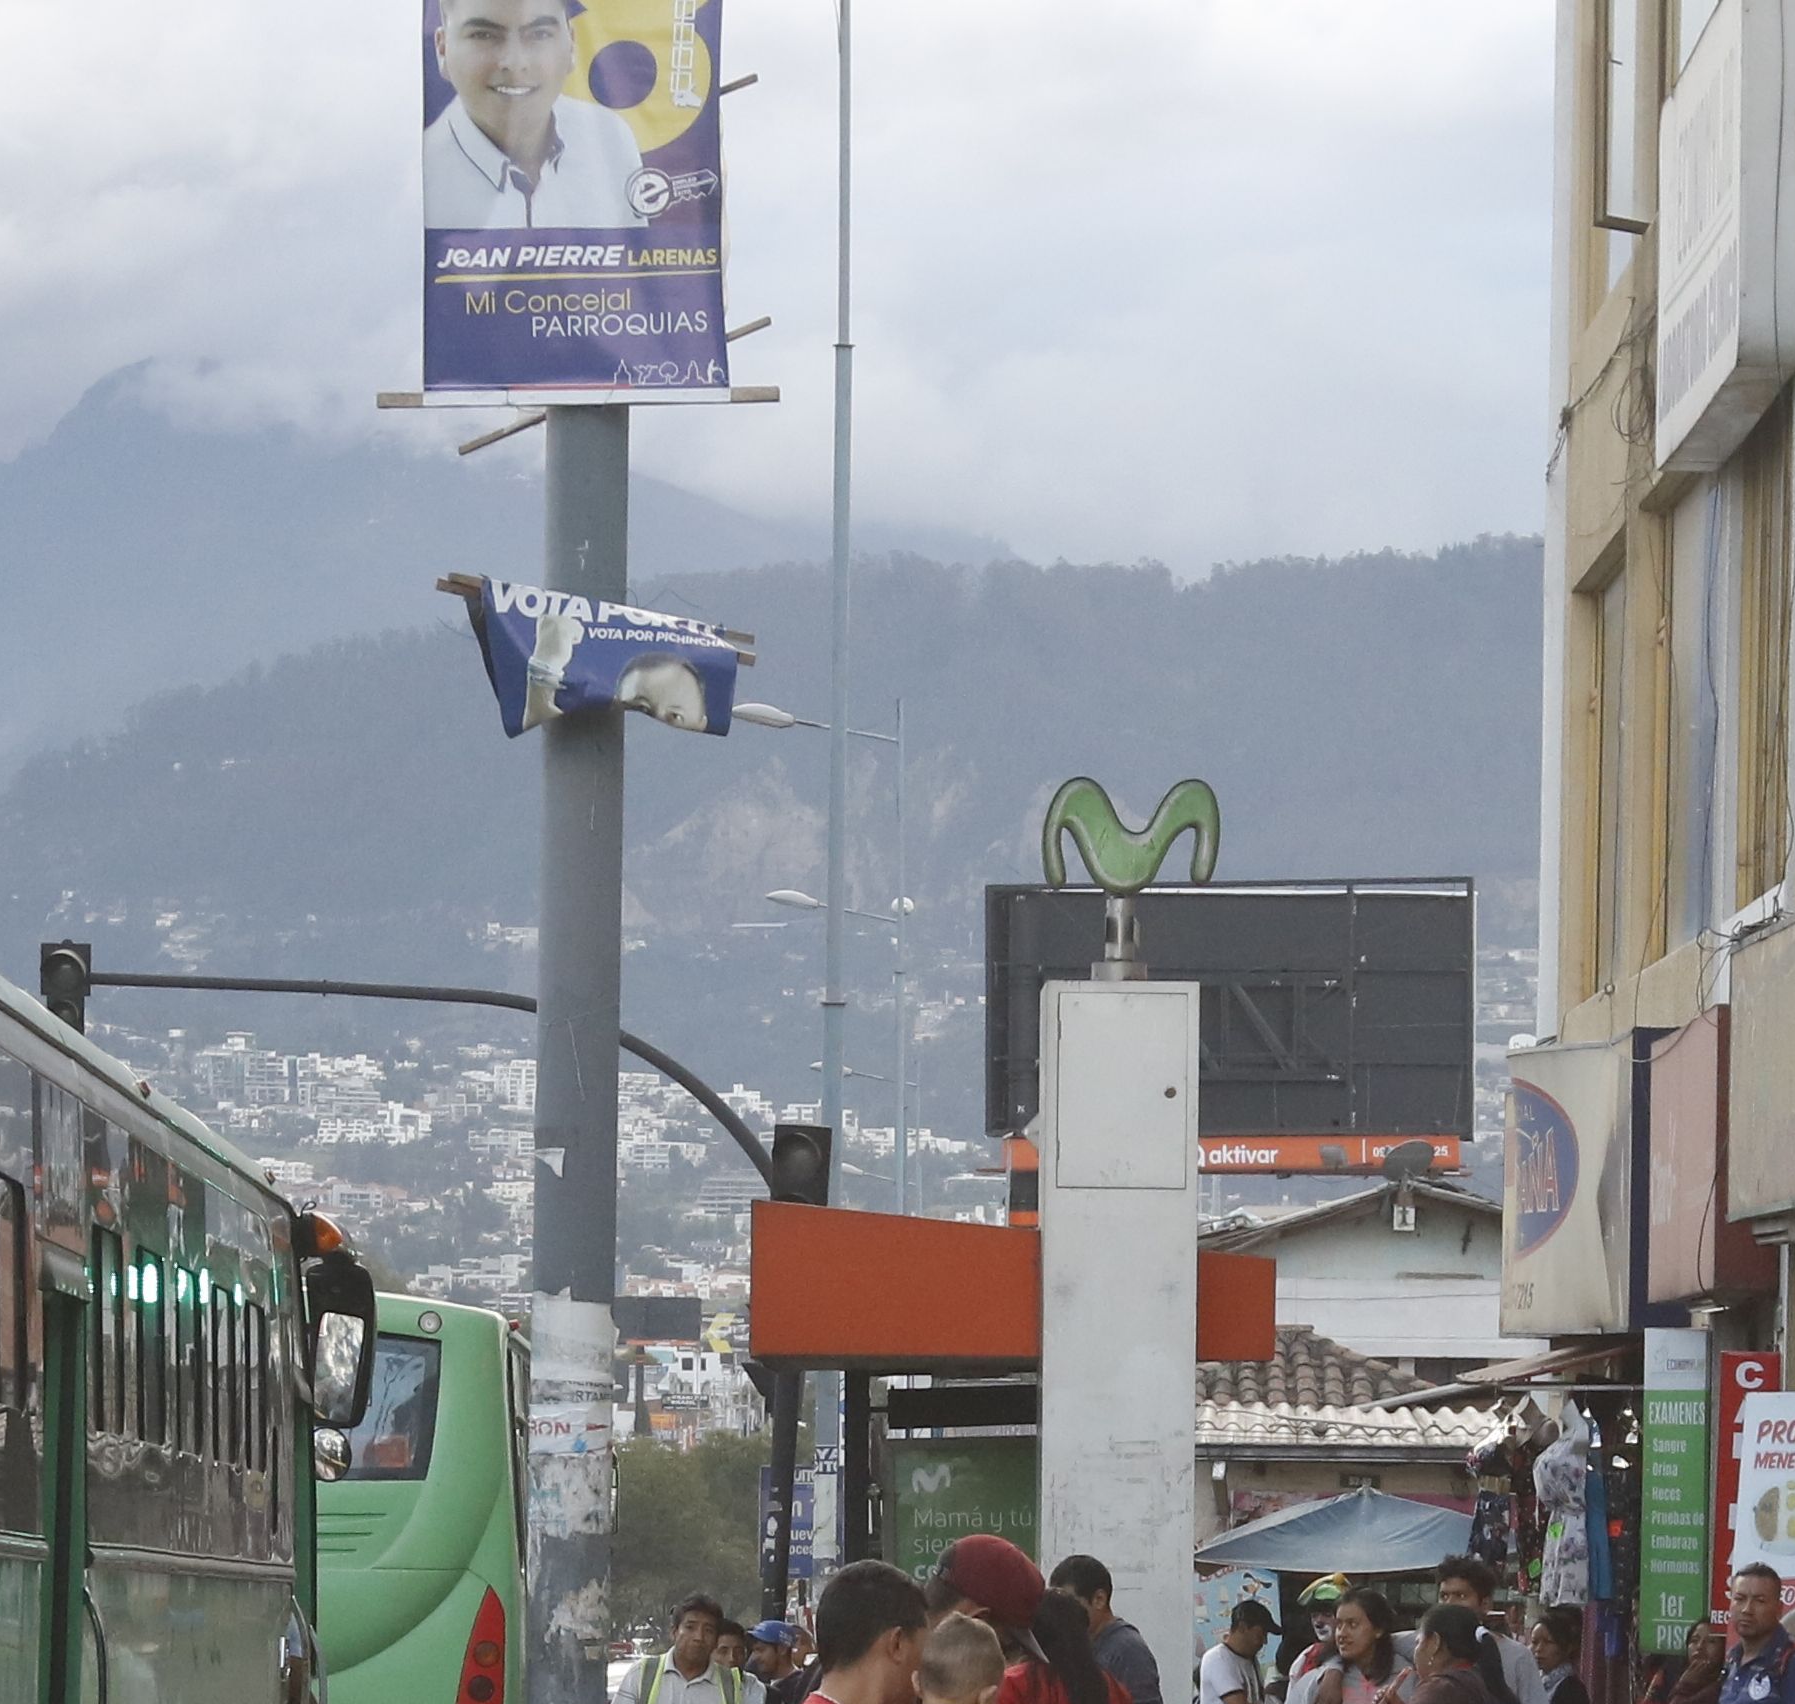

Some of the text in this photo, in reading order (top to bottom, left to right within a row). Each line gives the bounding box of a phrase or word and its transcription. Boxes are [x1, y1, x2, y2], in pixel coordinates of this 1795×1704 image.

[515, 244, 624, 268] PIERRE
[627, 248, 717, 267] LARENAS
[465, 288, 632, 319] Mi Concejal
[531, 311, 708, 338] PARROQUIAS
[491, 580, 593, 623] VOTA
[587, 627, 730, 649] VOTA POR PICHINCHA
[1208, 1146, 1278, 1164] aktivar
[1649, 1401, 1706, 1425] EXAMENES
[1652, 1438, 1687, 1455] Sangre
[1652, 1462, 1679, 1477] Orina
[1652, 1487, 1682, 1501] Heces
[914, 1505, 1032, 1533] Mamá y tú
[1651, 1510, 1705, 1526] Pruebas de
[1651, 1534, 1699, 1550] Embarazo
[1651, 1559, 1700, 1575] Hormonas
[1660, 1591, 1685, 1617] 1er
